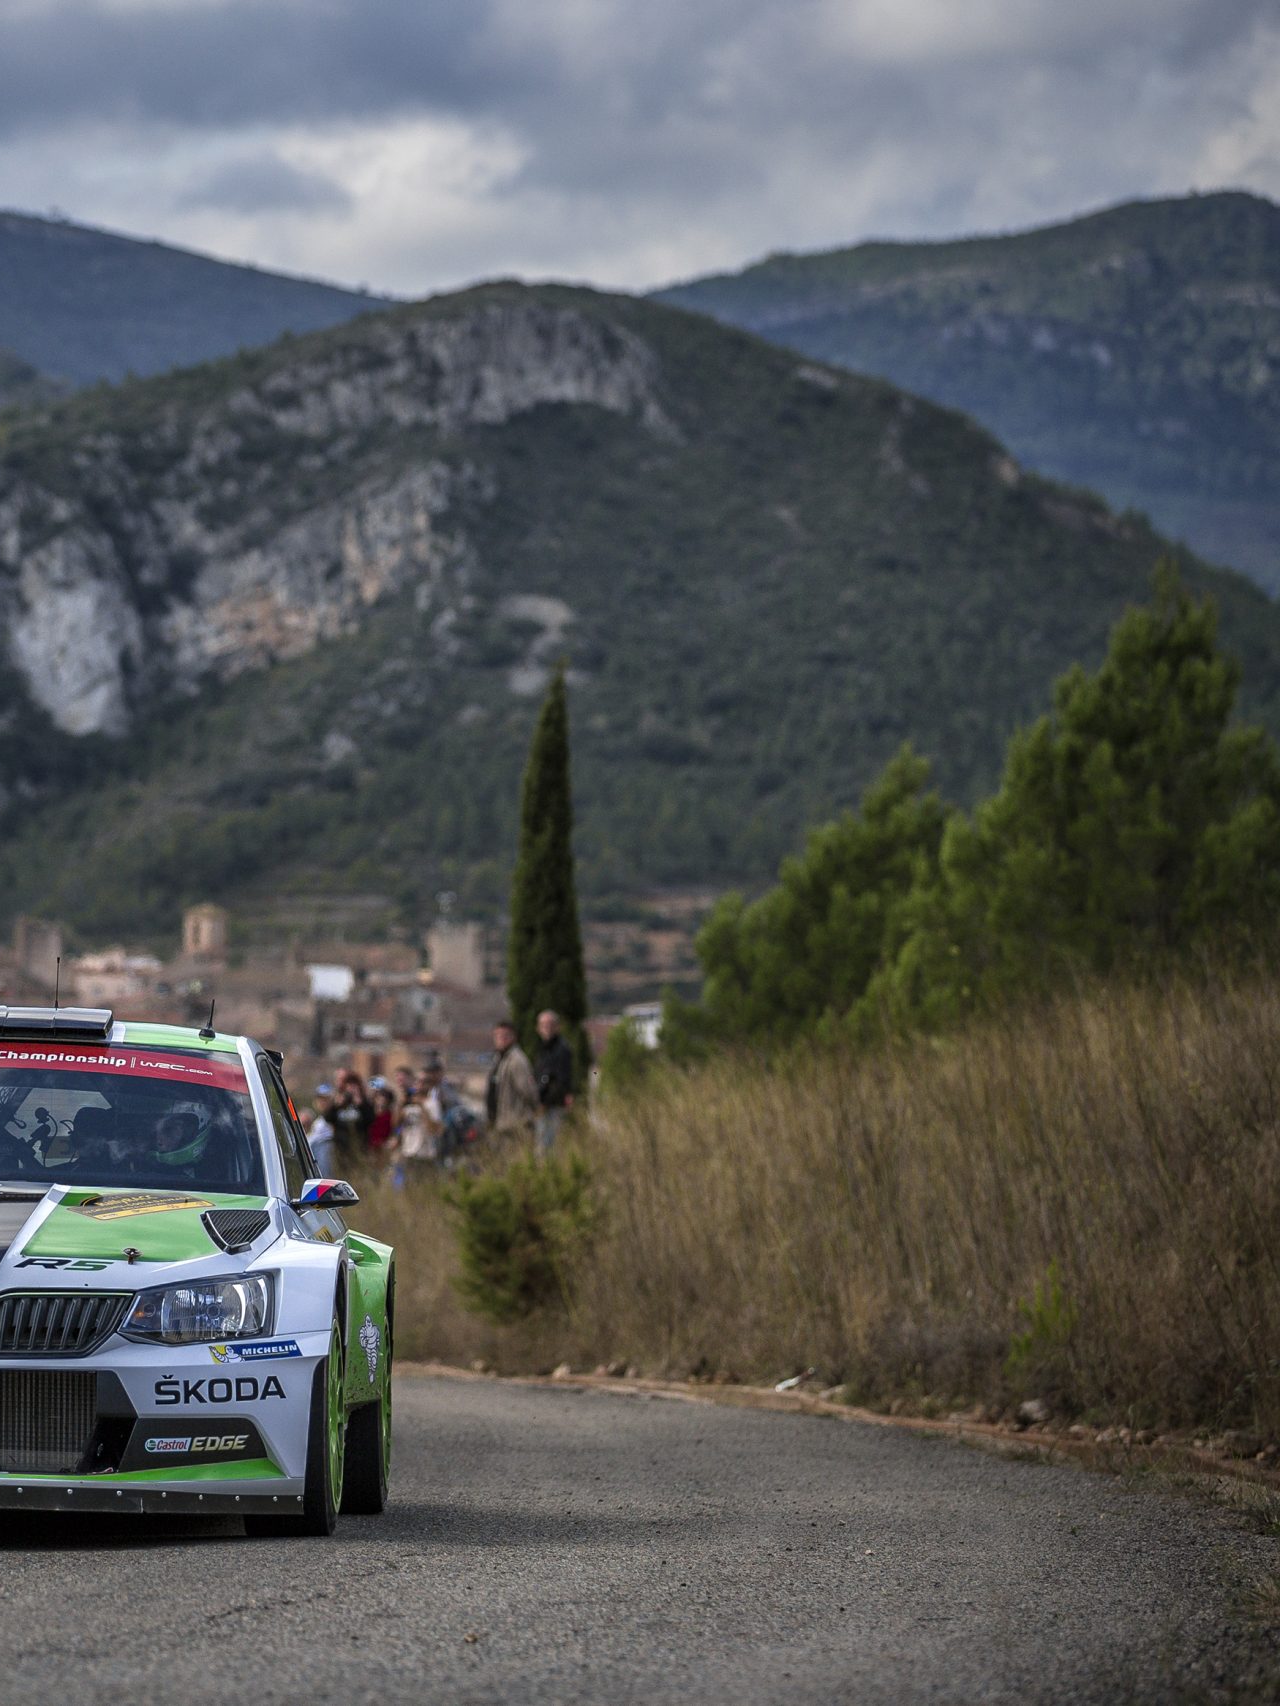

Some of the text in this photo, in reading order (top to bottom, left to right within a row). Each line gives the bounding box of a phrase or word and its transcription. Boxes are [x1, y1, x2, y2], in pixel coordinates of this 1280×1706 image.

[13, 1258, 115, 1271] R5
[242, 1344, 298, 1355] MICHELIN
[154, 1374, 287, 1405] ŠKODA
[156, 1434, 250, 1451] Castrol EDGE
